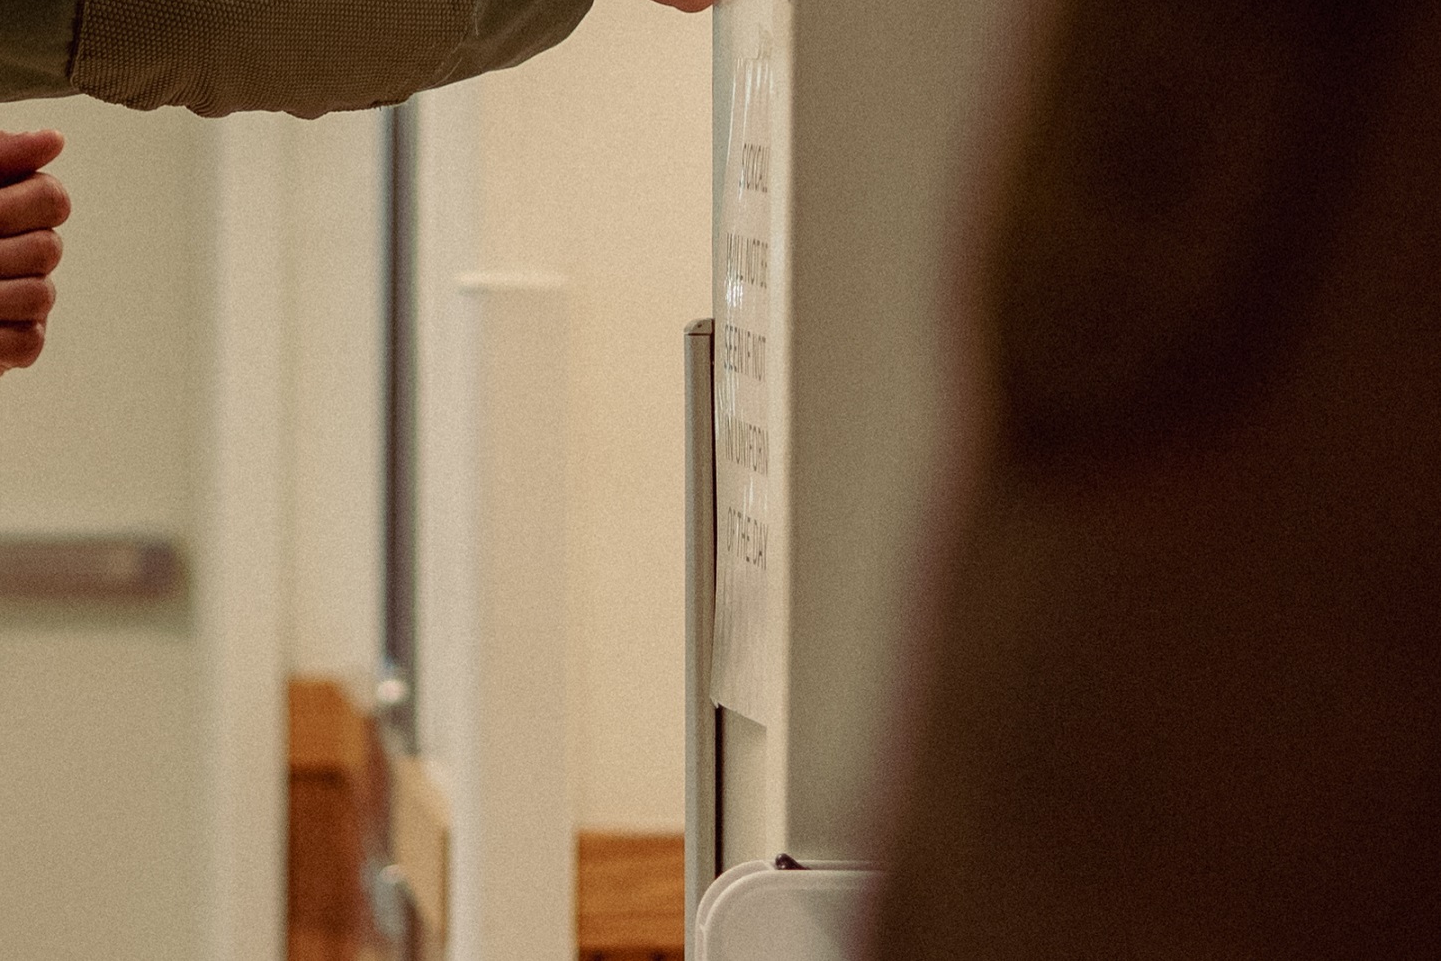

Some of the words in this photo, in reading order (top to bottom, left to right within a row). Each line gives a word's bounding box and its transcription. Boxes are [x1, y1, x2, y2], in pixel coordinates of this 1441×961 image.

[724, 323, 743, 374] SEEN
[752, 333, 766, 383] NOT
[737, 510, 750, 564] THE
[752, 518, 769, 571] DAY
